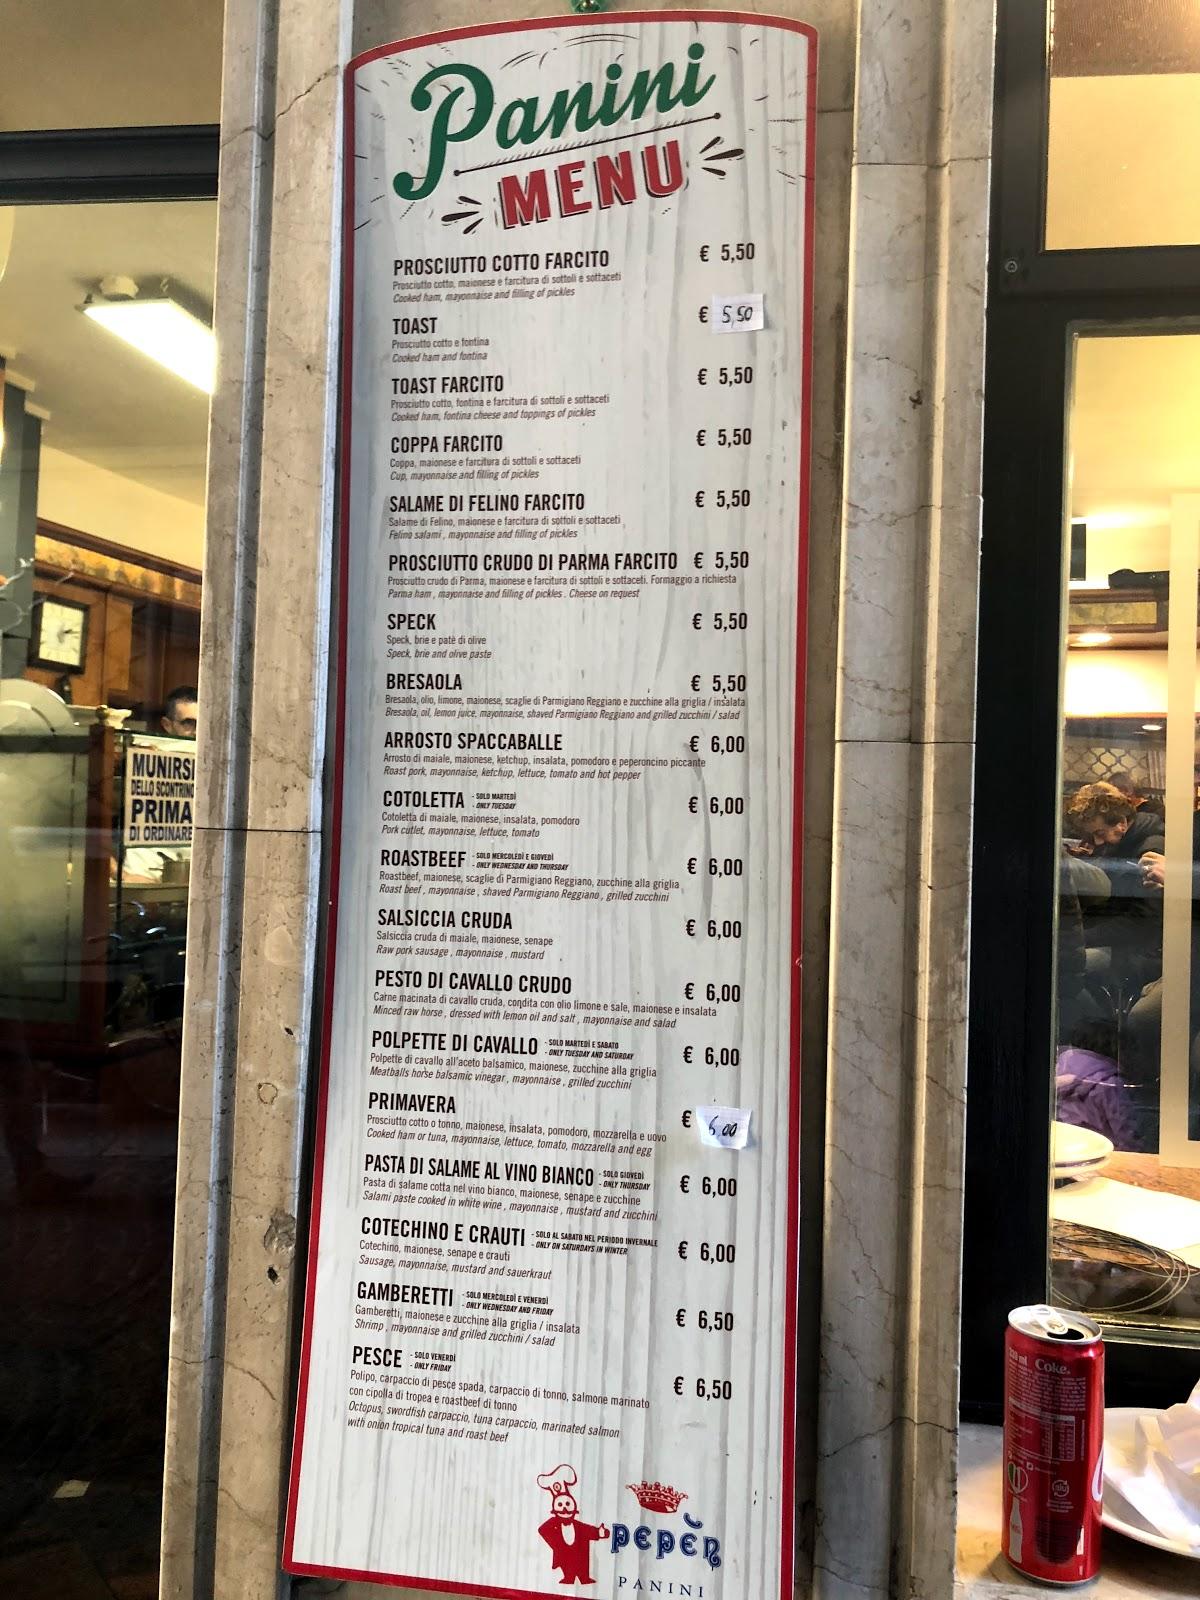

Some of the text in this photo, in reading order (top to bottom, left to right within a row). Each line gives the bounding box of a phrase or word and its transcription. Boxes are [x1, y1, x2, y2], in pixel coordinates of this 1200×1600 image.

[393, 42, 716, 200] Panini
[498, 139, 686, 230] MENU
[393, 249, 608, 276] PROSCIUTTO COTTO FARCITO
[700, 243, 754, 263] € 5,50
[699, 306, 708, 323] €
[392, 316, 437, 334] TOAST
[391, 374, 503, 394] TOAST FARCITO
[698, 367, 753, 386] € 5,50
[390, 434, 502, 453] COPPA FARCITO
[696, 428, 751, 448] € 5,50
[389, 492, 584, 512] SALAME DI FELINO FARCITO
[695, 490, 750, 509] € 5,50
[388, 552, 677, 571] PROSCIUTTO CRUDO DI PARMA FARCITO
[694, 551, 749, 571] € 5,50
[387, 613, 435, 630] SPECK
[692, 613, 747, 632] € 5,50
[386, 635, 411, 646] Speck,
[413, 635, 430, 645] brie
[457, 635, 465, 644] di
[467, 635, 486, 644] olive
[386, 673, 462, 690] BRESAOLA
[691, 675, 746, 696] € 5,50
[383, 731, 562, 750] ARROSTO SPACCABALLE
[689, 736, 745, 755] € 6,00
[132, 753, 195, 781] MUNIRSI
[131, 779, 154, 796] DELLO
[382, 790, 464, 808] COTOLETTA
[689, 796, 743, 816] € 6,00
[131, 799, 192, 824] PRIMA
[381, 811, 580, 826] Cotoletta di maiale, maionese, insalata, pomodoro
[130, 825, 192, 842] DI ORDINARE
[380, 824, 540, 839] Pork cutlet, mayonnaise, lettuce, tomato
[380, 849, 466, 867] ROASTBEEF
[687, 858, 742, 878] € 6,00
[377, 908, 512, 929] SALSICCIA CRUDA
[376, 929, 553, 947] Salsiccia cruda di maiale, maionese, senape
[686, 919, 741, 940] € 6,00
[374, 969, 571, 994] PESTO DI CAVALLO CRUDO
[685, 983, 740, 1004] € 6,00
[371, 1030, 537, 1055] POLPETTE DI CAVALLO
[683, 1046, 739, 1068] € 6,00
[368, 1091, 455, 1113] PRIMAVERA
[682, 1110, 692, 1128] €
[364, 1153, 593, 1186] PASTA DI SALAME AL VINO BIANCO
[680, 1175, 737, 1198] € 6,00
[361, 1216, 525, 1246] COTECHINO E CRAUTI
[359, 1239, 510, 1261] Cotechino, maionese, senape e crauti
[678, 1241, 735, 1264] € 6,00
[358, 1253, 552, 1279] Sausage, mayonnaise, mustard and sauerkraut
[357, 1280, 453, 1306] GAMBERETTI
[676, 1309, 733, 1332] € 6,50
[352, 1345, 402, 1368] PESCE
[348, 1386, 517, 1411] con cipolla di tropea e roastbeef di tonno
[674, 1376, 731, 1401] € 6,50
[347, 1416, 509, 1442] with onion tropical tuna and roast beef
[618, 1576, 704, 1598] PANINI
